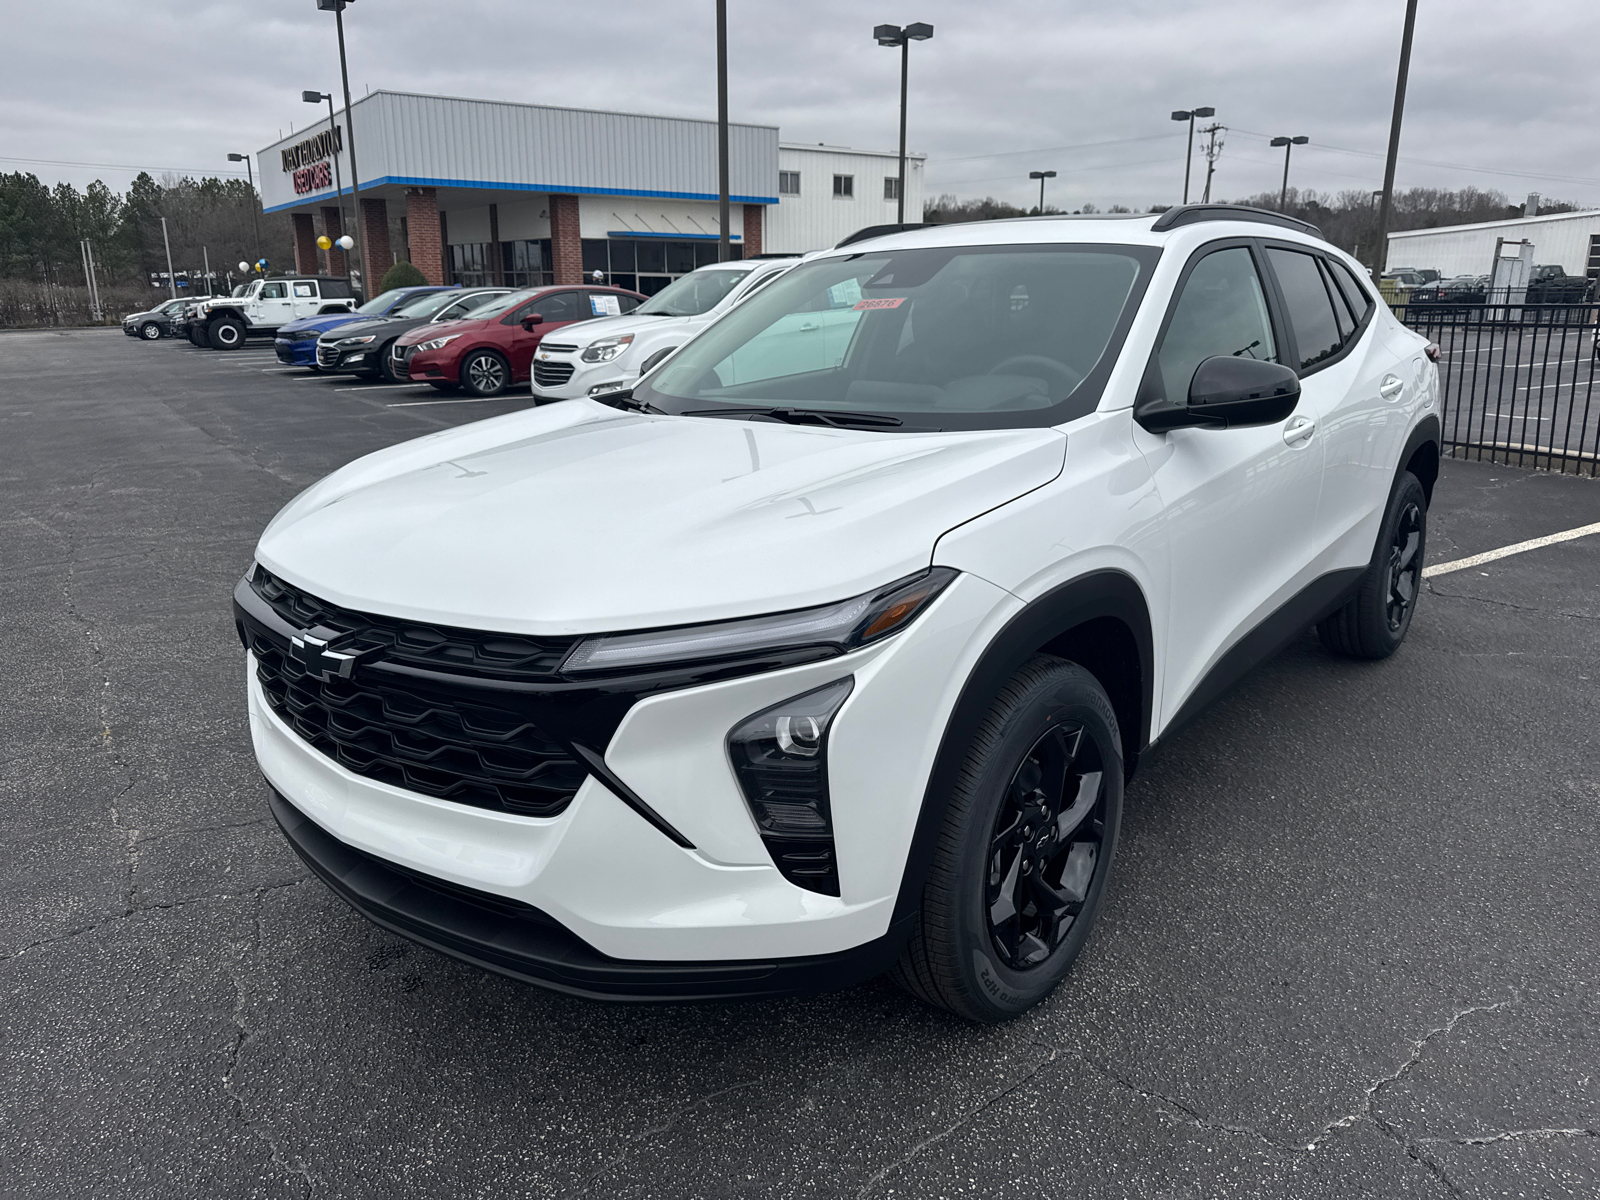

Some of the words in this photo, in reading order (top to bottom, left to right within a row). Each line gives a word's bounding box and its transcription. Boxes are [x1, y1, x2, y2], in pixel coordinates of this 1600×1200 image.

[281, 145, 301, 172] JOHN
[298, 125, 343, 166] THORNTON
[292, 168, 312, 194] USED
[311, 160, 332, 190] CARS
[859, 299, 897, 309] 26876
[980, 968, 1000, 996] HP2
